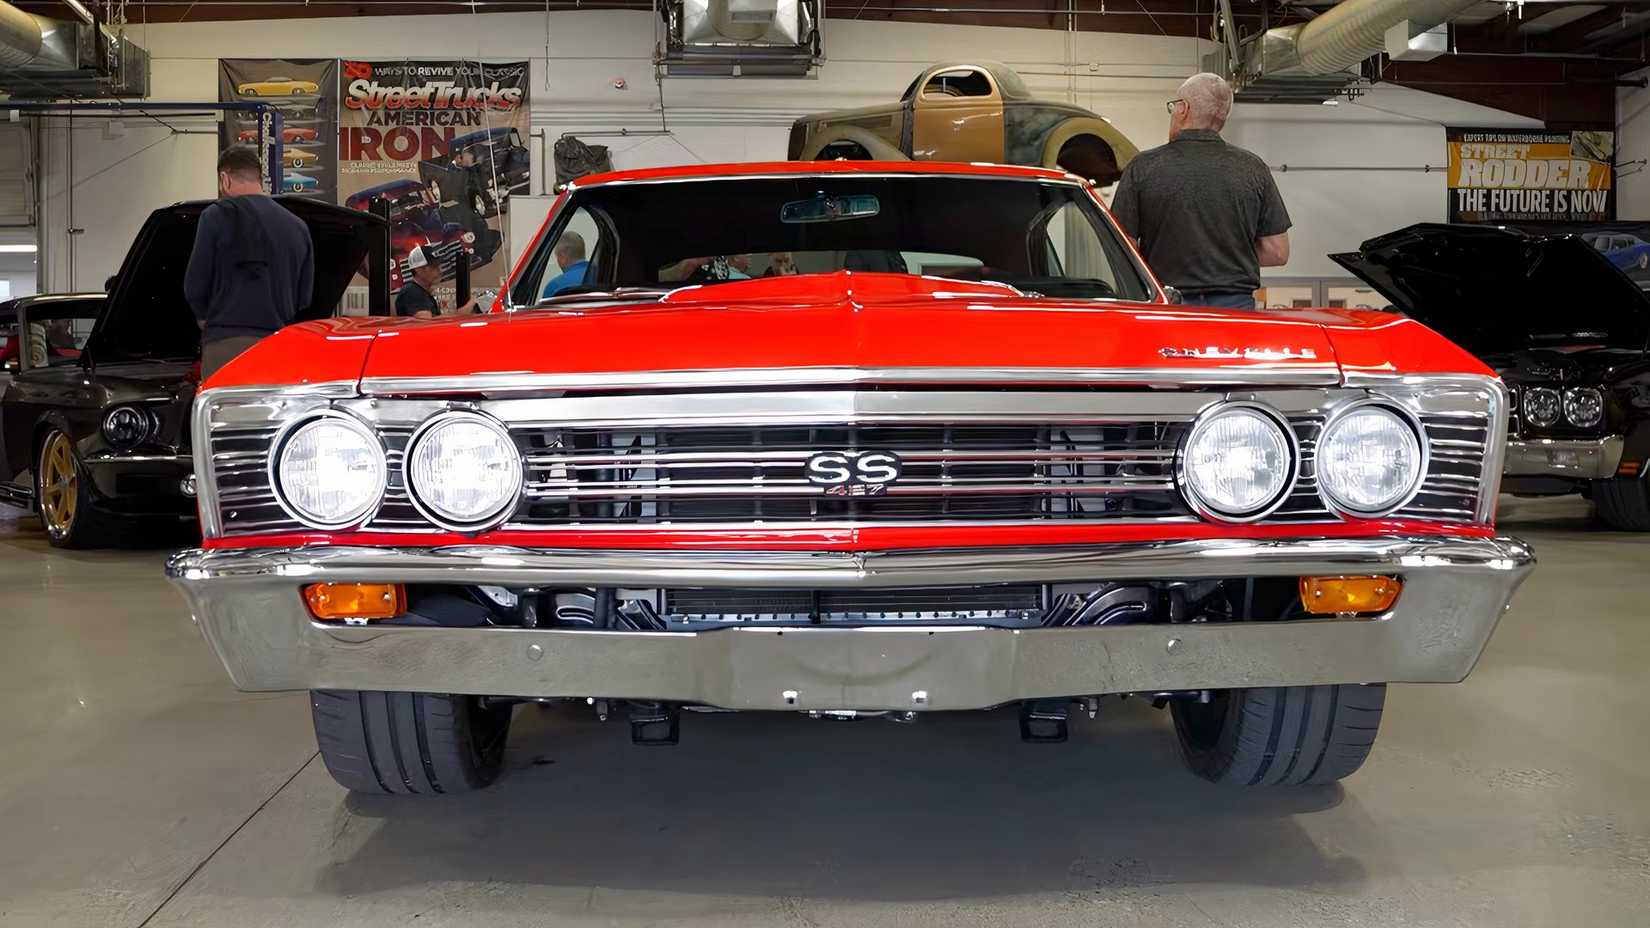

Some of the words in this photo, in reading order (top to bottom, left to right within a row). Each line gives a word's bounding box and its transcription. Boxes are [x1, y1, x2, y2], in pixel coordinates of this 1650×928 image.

[375, 66, 401, 76] WAYS
[403, 66, 417, 76] TO
[417, 66, 453, 76] REVIVE
[367, 111, 481, 126] AMERICAN
[339, 127, 455, 160] IRON
[1460, 143, 1531, 159] STREET
[1458, 159, 1592, 187] RODDER
[1458, 189, 1487, 212] THE
[1491, 189, 1550, 212] FUTURE
[1553, 190, 1568, 212] IS
[1571, 190, 1607, 213] NOW
[808, 454, 898, 483] SS
